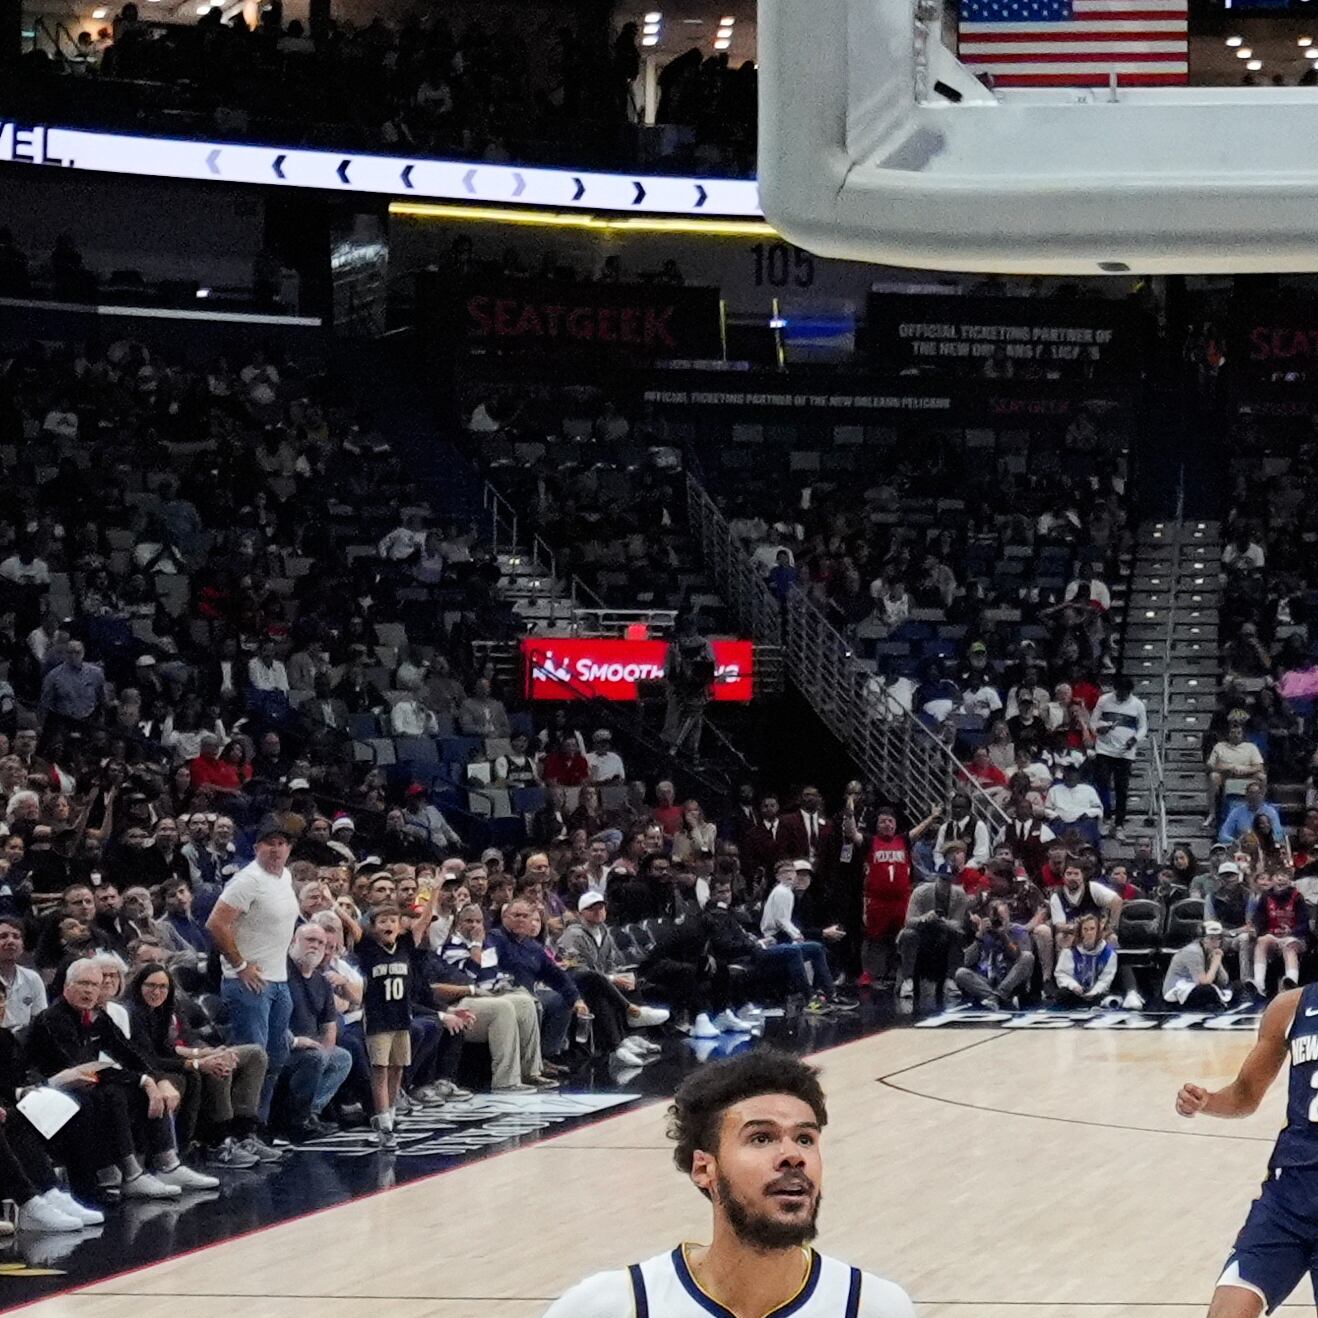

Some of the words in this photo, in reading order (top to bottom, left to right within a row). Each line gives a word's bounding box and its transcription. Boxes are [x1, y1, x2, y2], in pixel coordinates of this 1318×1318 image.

[0, 122, 75, 167] EL.
[751, 243, 815, 287] 105
[467, 295, 676, 349] SEATGEEK
[898, 323, 957, 338] OFFICIAL
[961, 325, 1030, 341] TICKETING
[1032, 327, 1094, 343] PARTNER
[1095, 330, 1112, 345] OF
[912, 341, 937, 356] THE
[939, 342, 970, 357] NEW
[576, 658, 666, 682] SMOOTH
[384, 977, 404, 1001] 10
